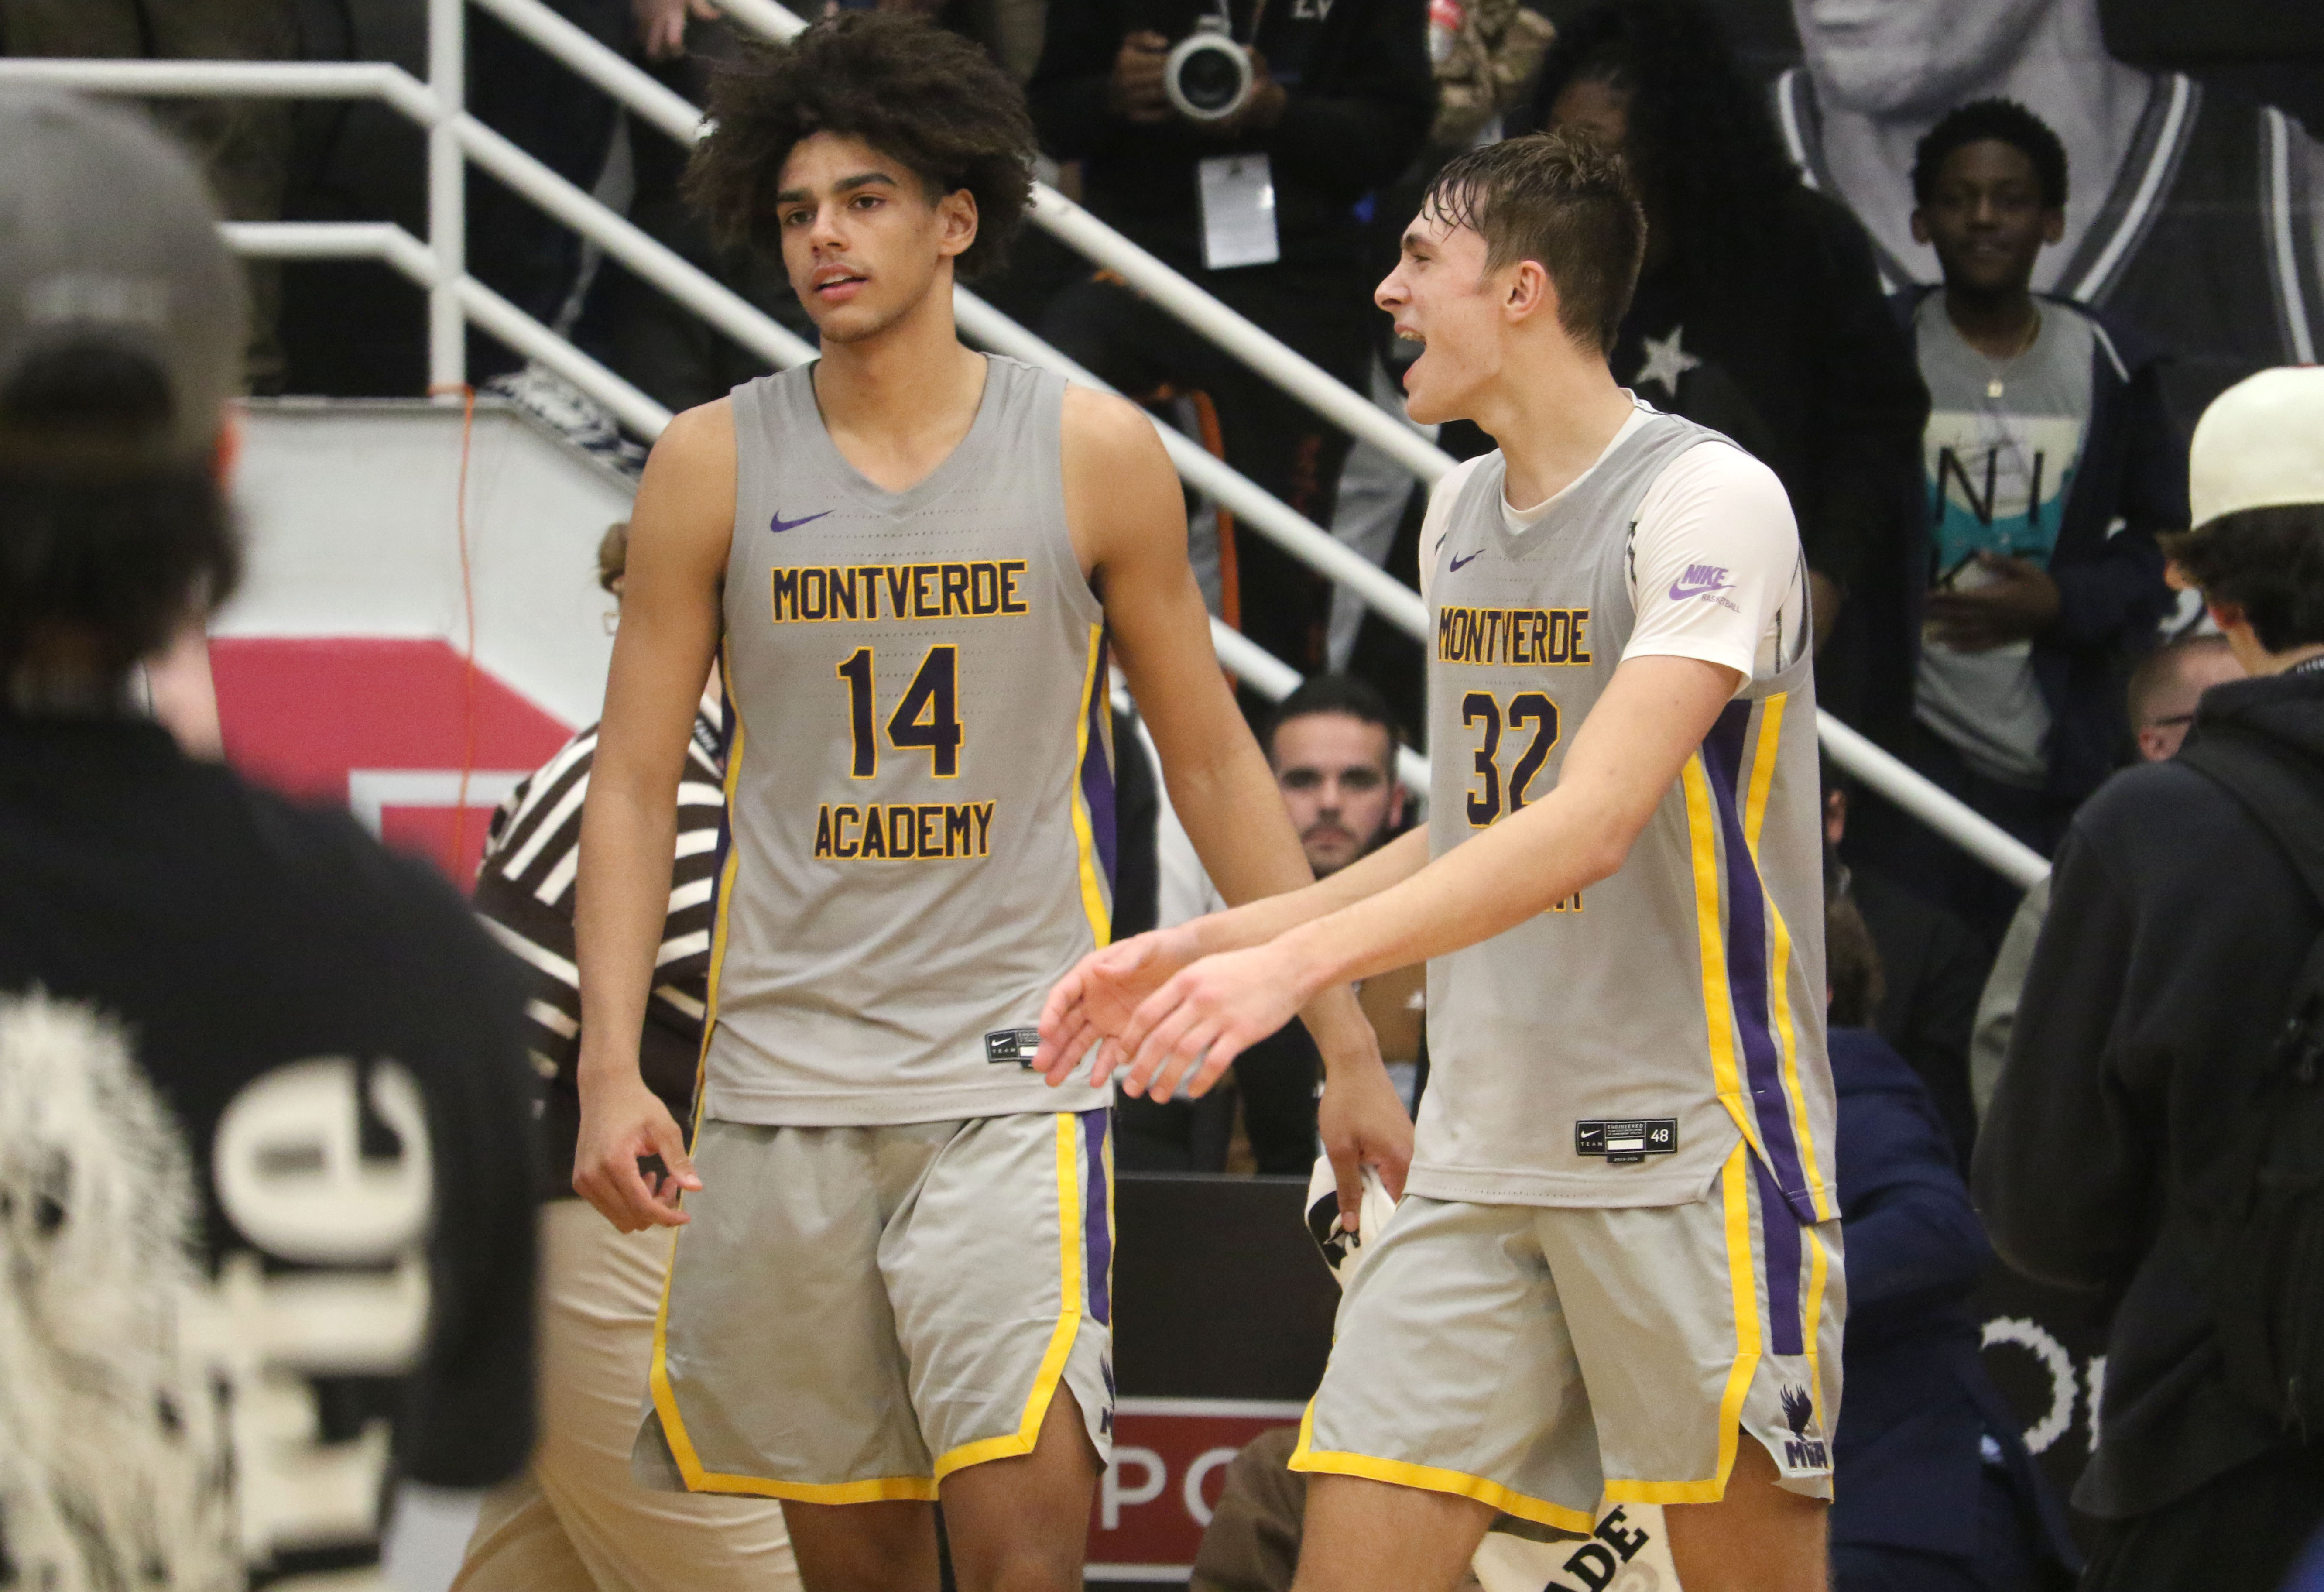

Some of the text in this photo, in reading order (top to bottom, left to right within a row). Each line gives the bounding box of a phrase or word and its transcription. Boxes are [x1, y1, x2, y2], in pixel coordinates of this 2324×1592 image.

[771, 559, 1029, 623] MONTVERDE
[1681, 564, 1729, 589] NIKE
[1438, 605, 1594, 666] MONTVERDE
[836, 643, 965, 780] 14
[1462, 690, 1561, 829] 32
[814, 799, 997, 860] ACADEMY
[1650, 1129, 1669, 1143] 48
